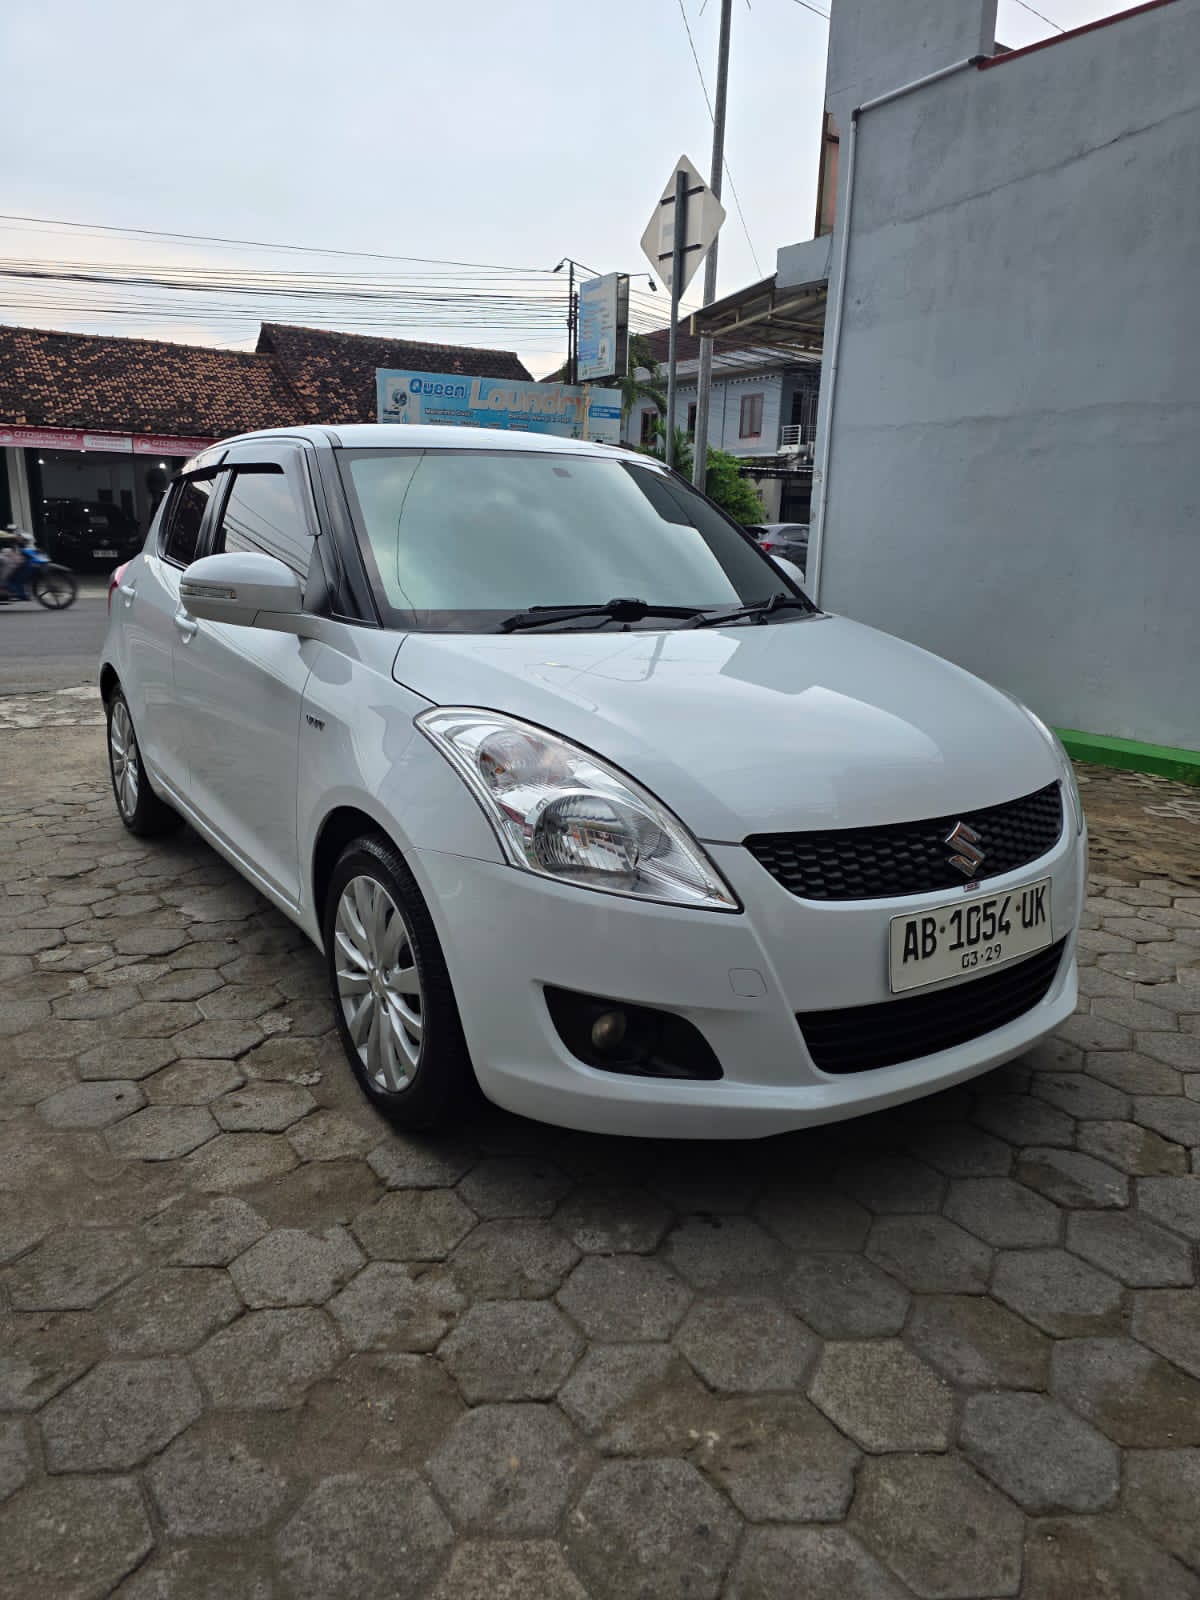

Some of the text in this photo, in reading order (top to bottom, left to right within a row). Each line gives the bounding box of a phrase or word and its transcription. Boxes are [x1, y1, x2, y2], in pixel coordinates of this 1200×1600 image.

[409, 378, 465, 398] Queen
[902, 885, 1047, 964] AB 1054 UK
